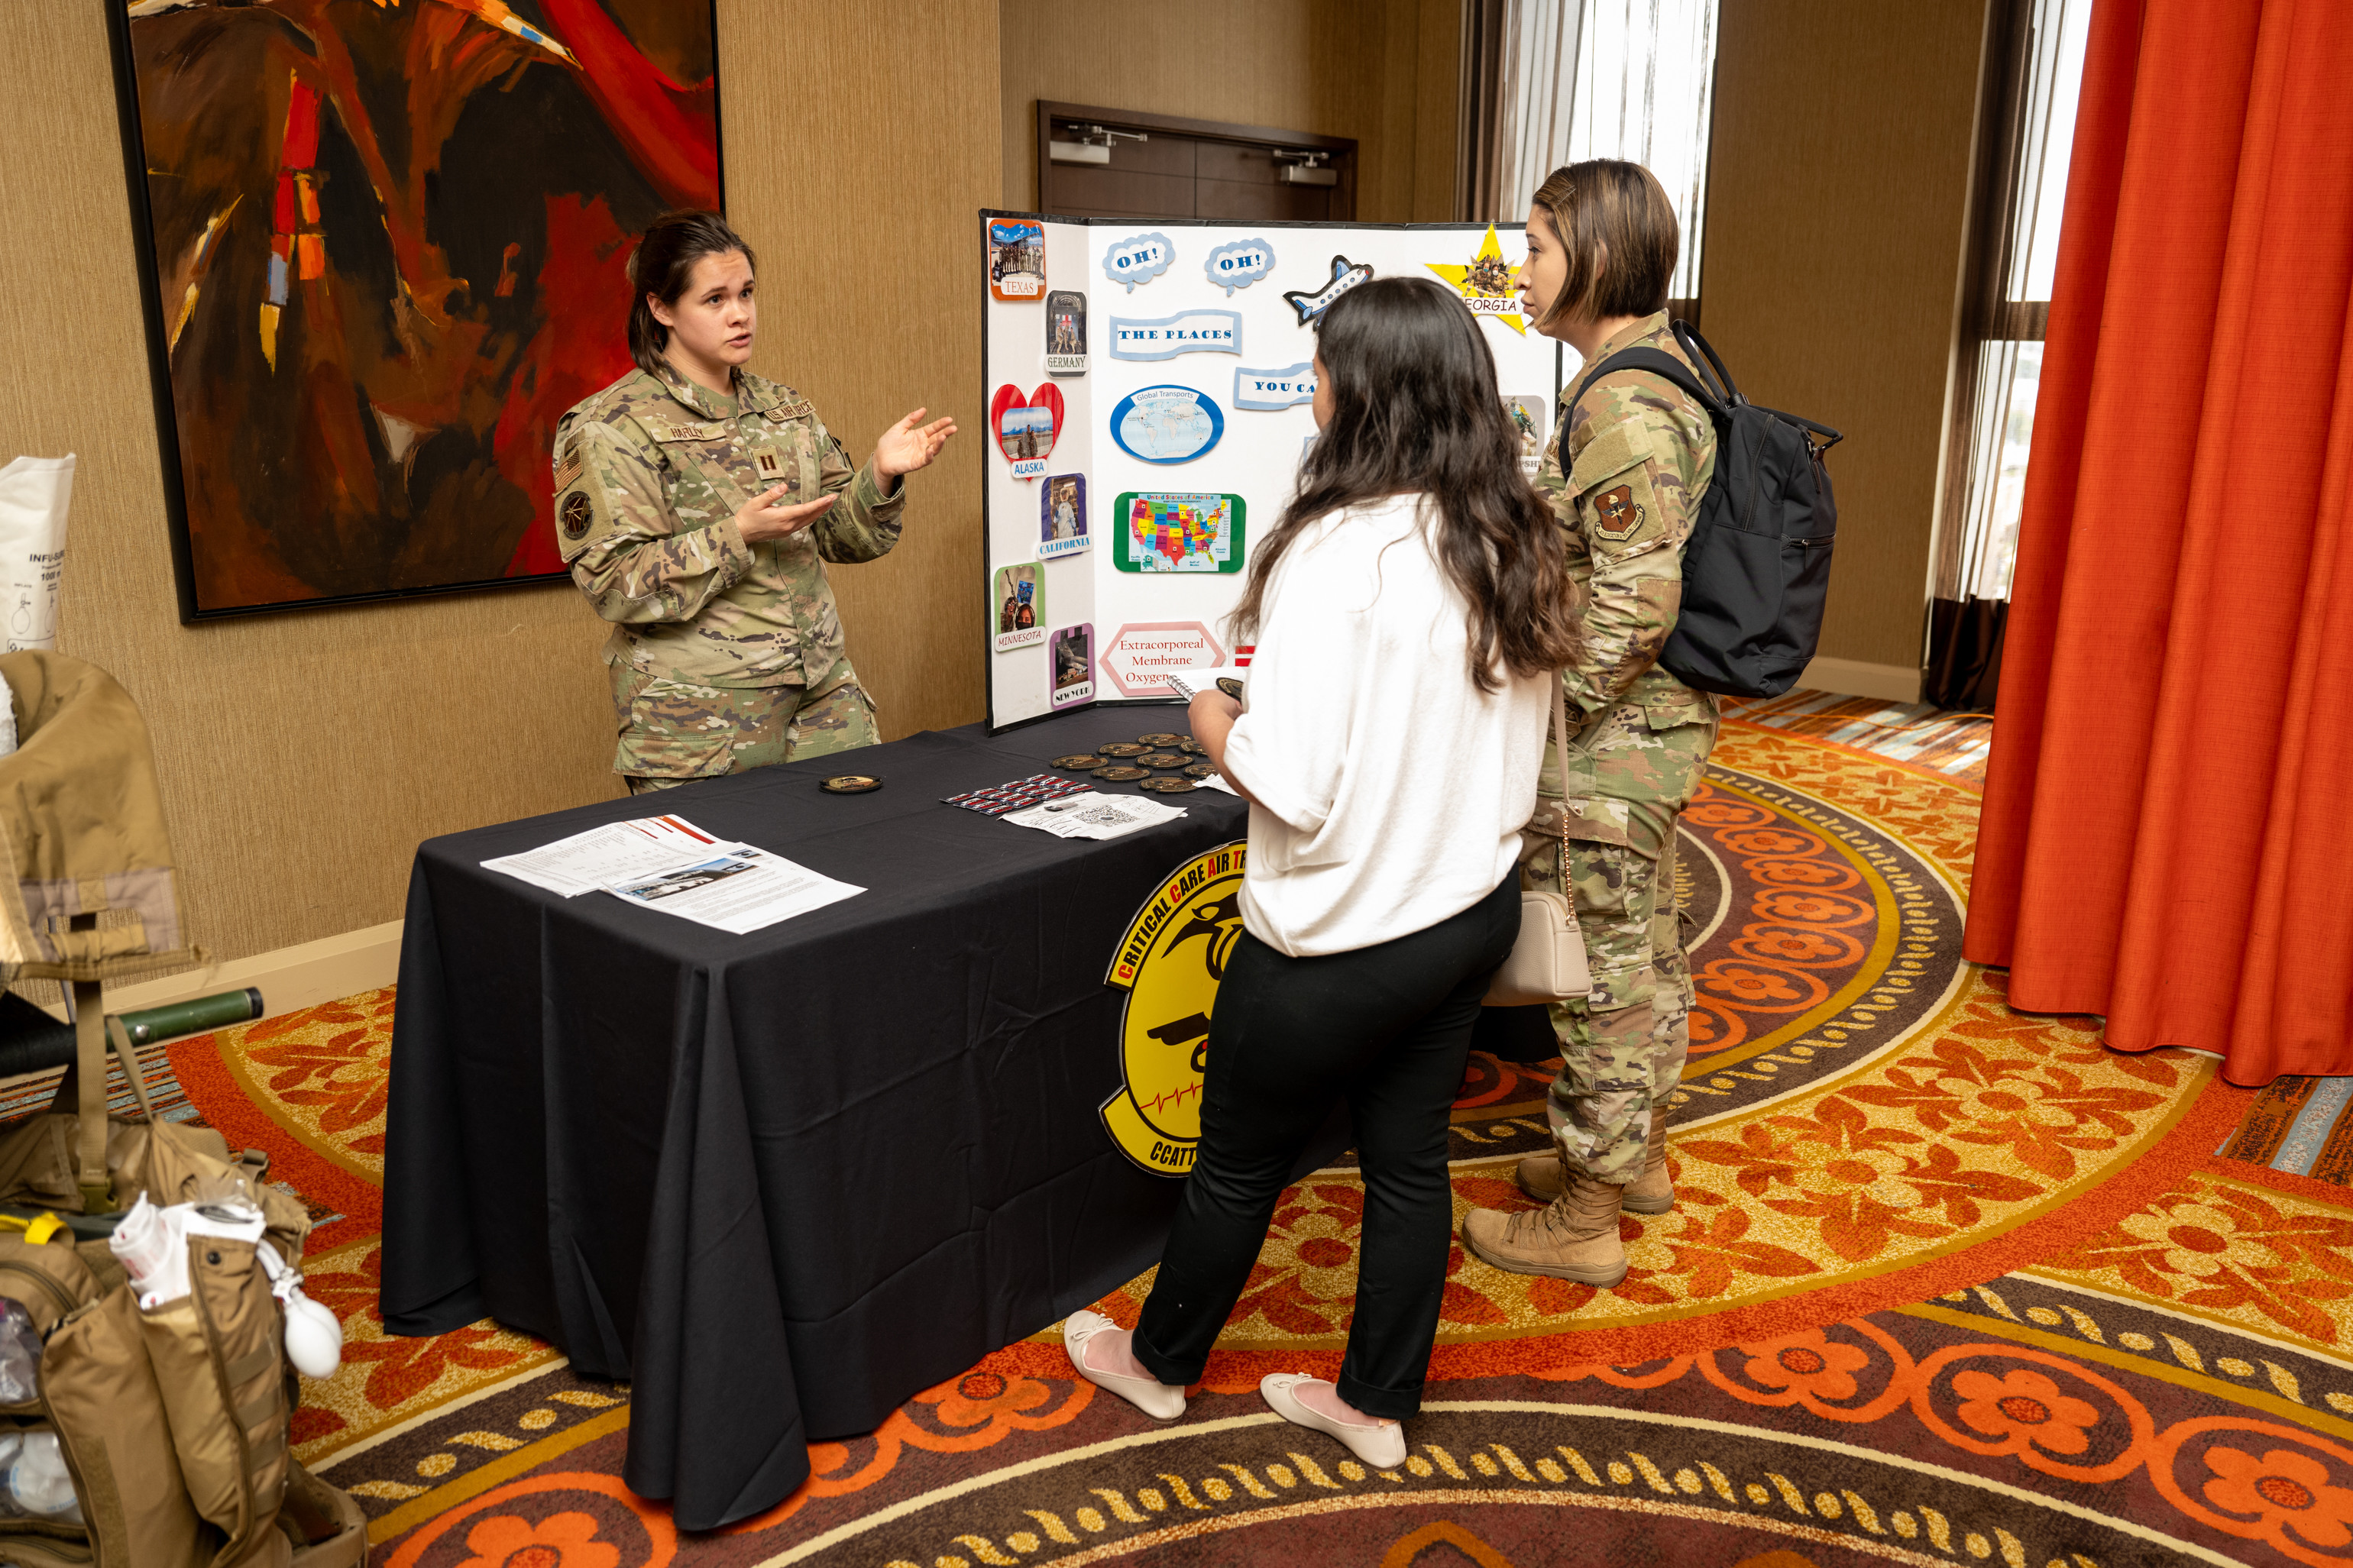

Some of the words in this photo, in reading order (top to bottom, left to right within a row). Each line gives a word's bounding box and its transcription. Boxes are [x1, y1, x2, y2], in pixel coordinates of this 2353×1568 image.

[1117, 247, 1159, 268] OH!
[1220, 254, 1261, 270] OH!
[1005, 280, 1034, 294] TEXAS
[1465, 298, 1516, 311] EORGIA
[1118, 330, 1158, 340] THE
[1165, 329, 1232, 340] PLACES
[1047, 355, 1086, 368] GERMANY
[1254, 381, 1291, 392] YOU
[1296, 383, 1316, 393] CA
[1137, 391, 1158, 401] Global
[1159, 390, 1193, 399] Transports
[780, 406, 797, 418] AIR
[670, 427, 705, 438] HARLEY
[1015, 461, 1044, 475] ALASKA
[1039, 537, 1090, 554] CALIFORNIA
[998, 629, 1042, 648] MINNESOTA
[1120, 638, 1204, 651] Extracorporeal
[1132, 655, 1193, 666] Membrane
[1126, 672, 1170, 685] Oxygen
[1055, 692, 1070, 703] NEW
[1071, 687, 1090, 697] YORK
[1118, 898, 1172, 980] CRITICAL
[1169, 862, 1206, 904] CARE
[1208, 852, 1230, 879] AIR
[1233, 849, 1247, 870] TR
[1150, 1141, 1197, 1166] CCATT
